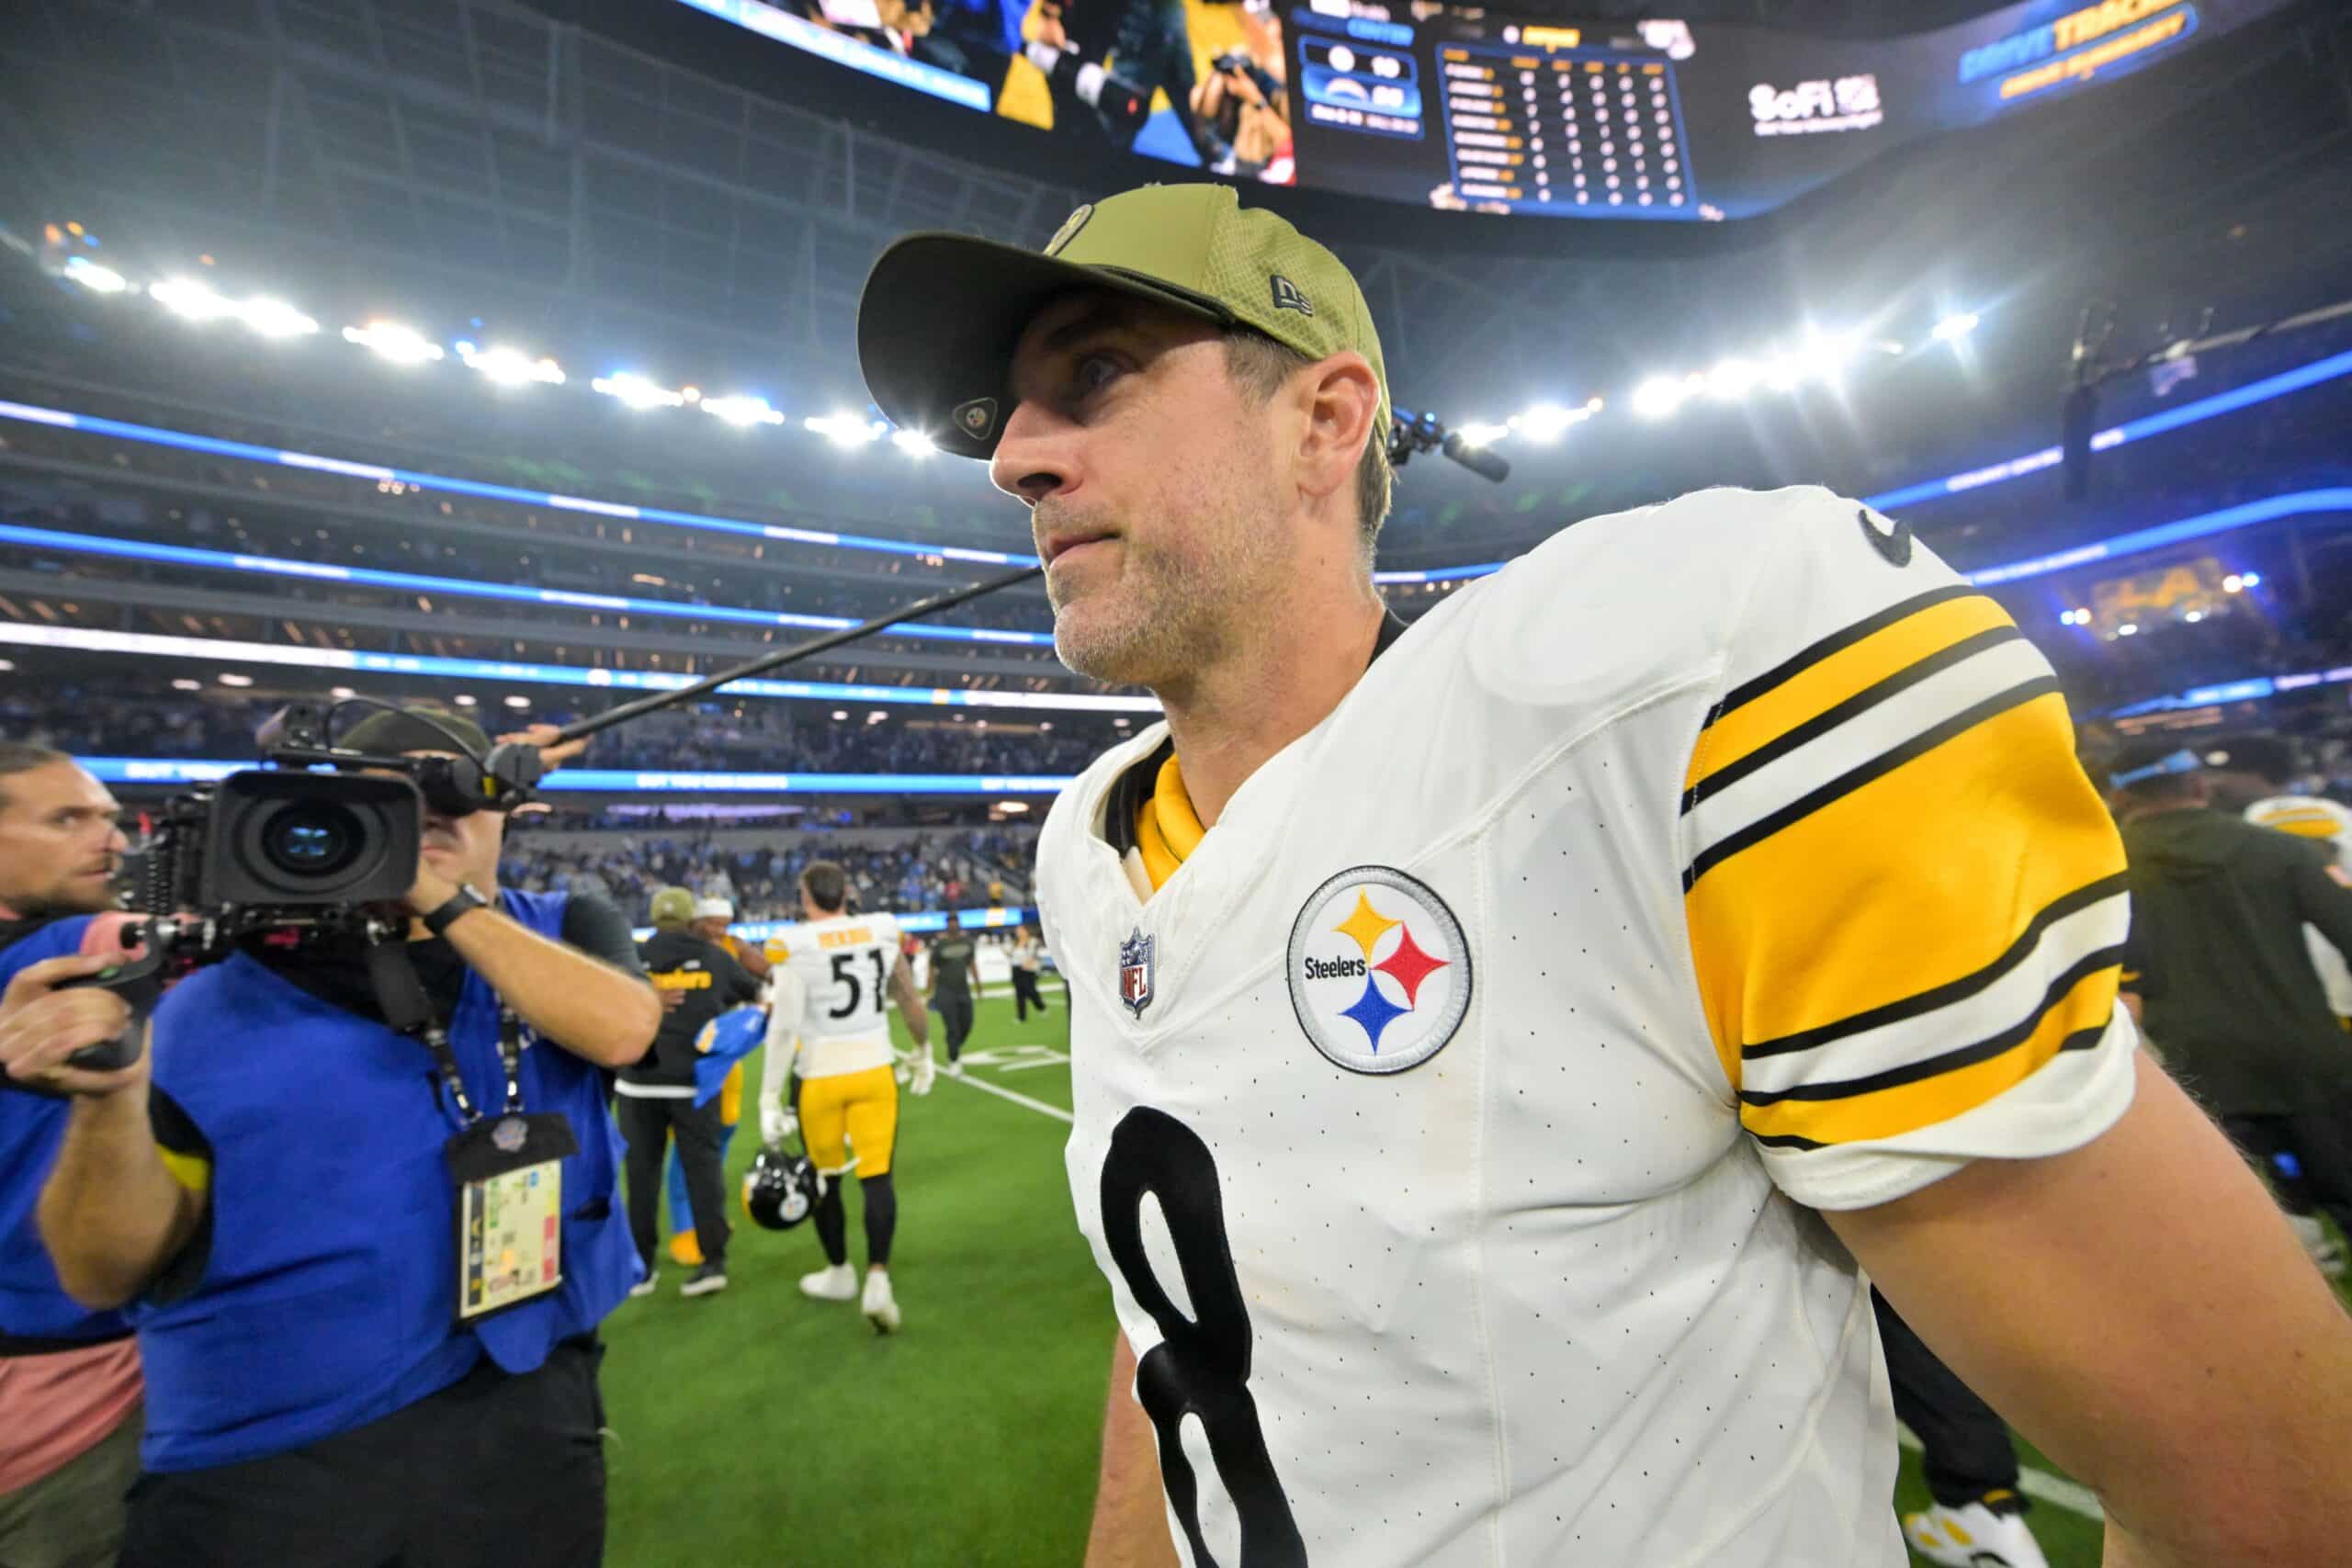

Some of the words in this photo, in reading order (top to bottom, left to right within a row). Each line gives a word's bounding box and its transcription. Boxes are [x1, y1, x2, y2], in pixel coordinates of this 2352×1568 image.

[829, 948, 885, 1019] 51
[1123, 966, 1148, 1001] NFL
[1305, 954, 1367, 980] Steelers
[1101, 1105, 1309, 1568] 8
